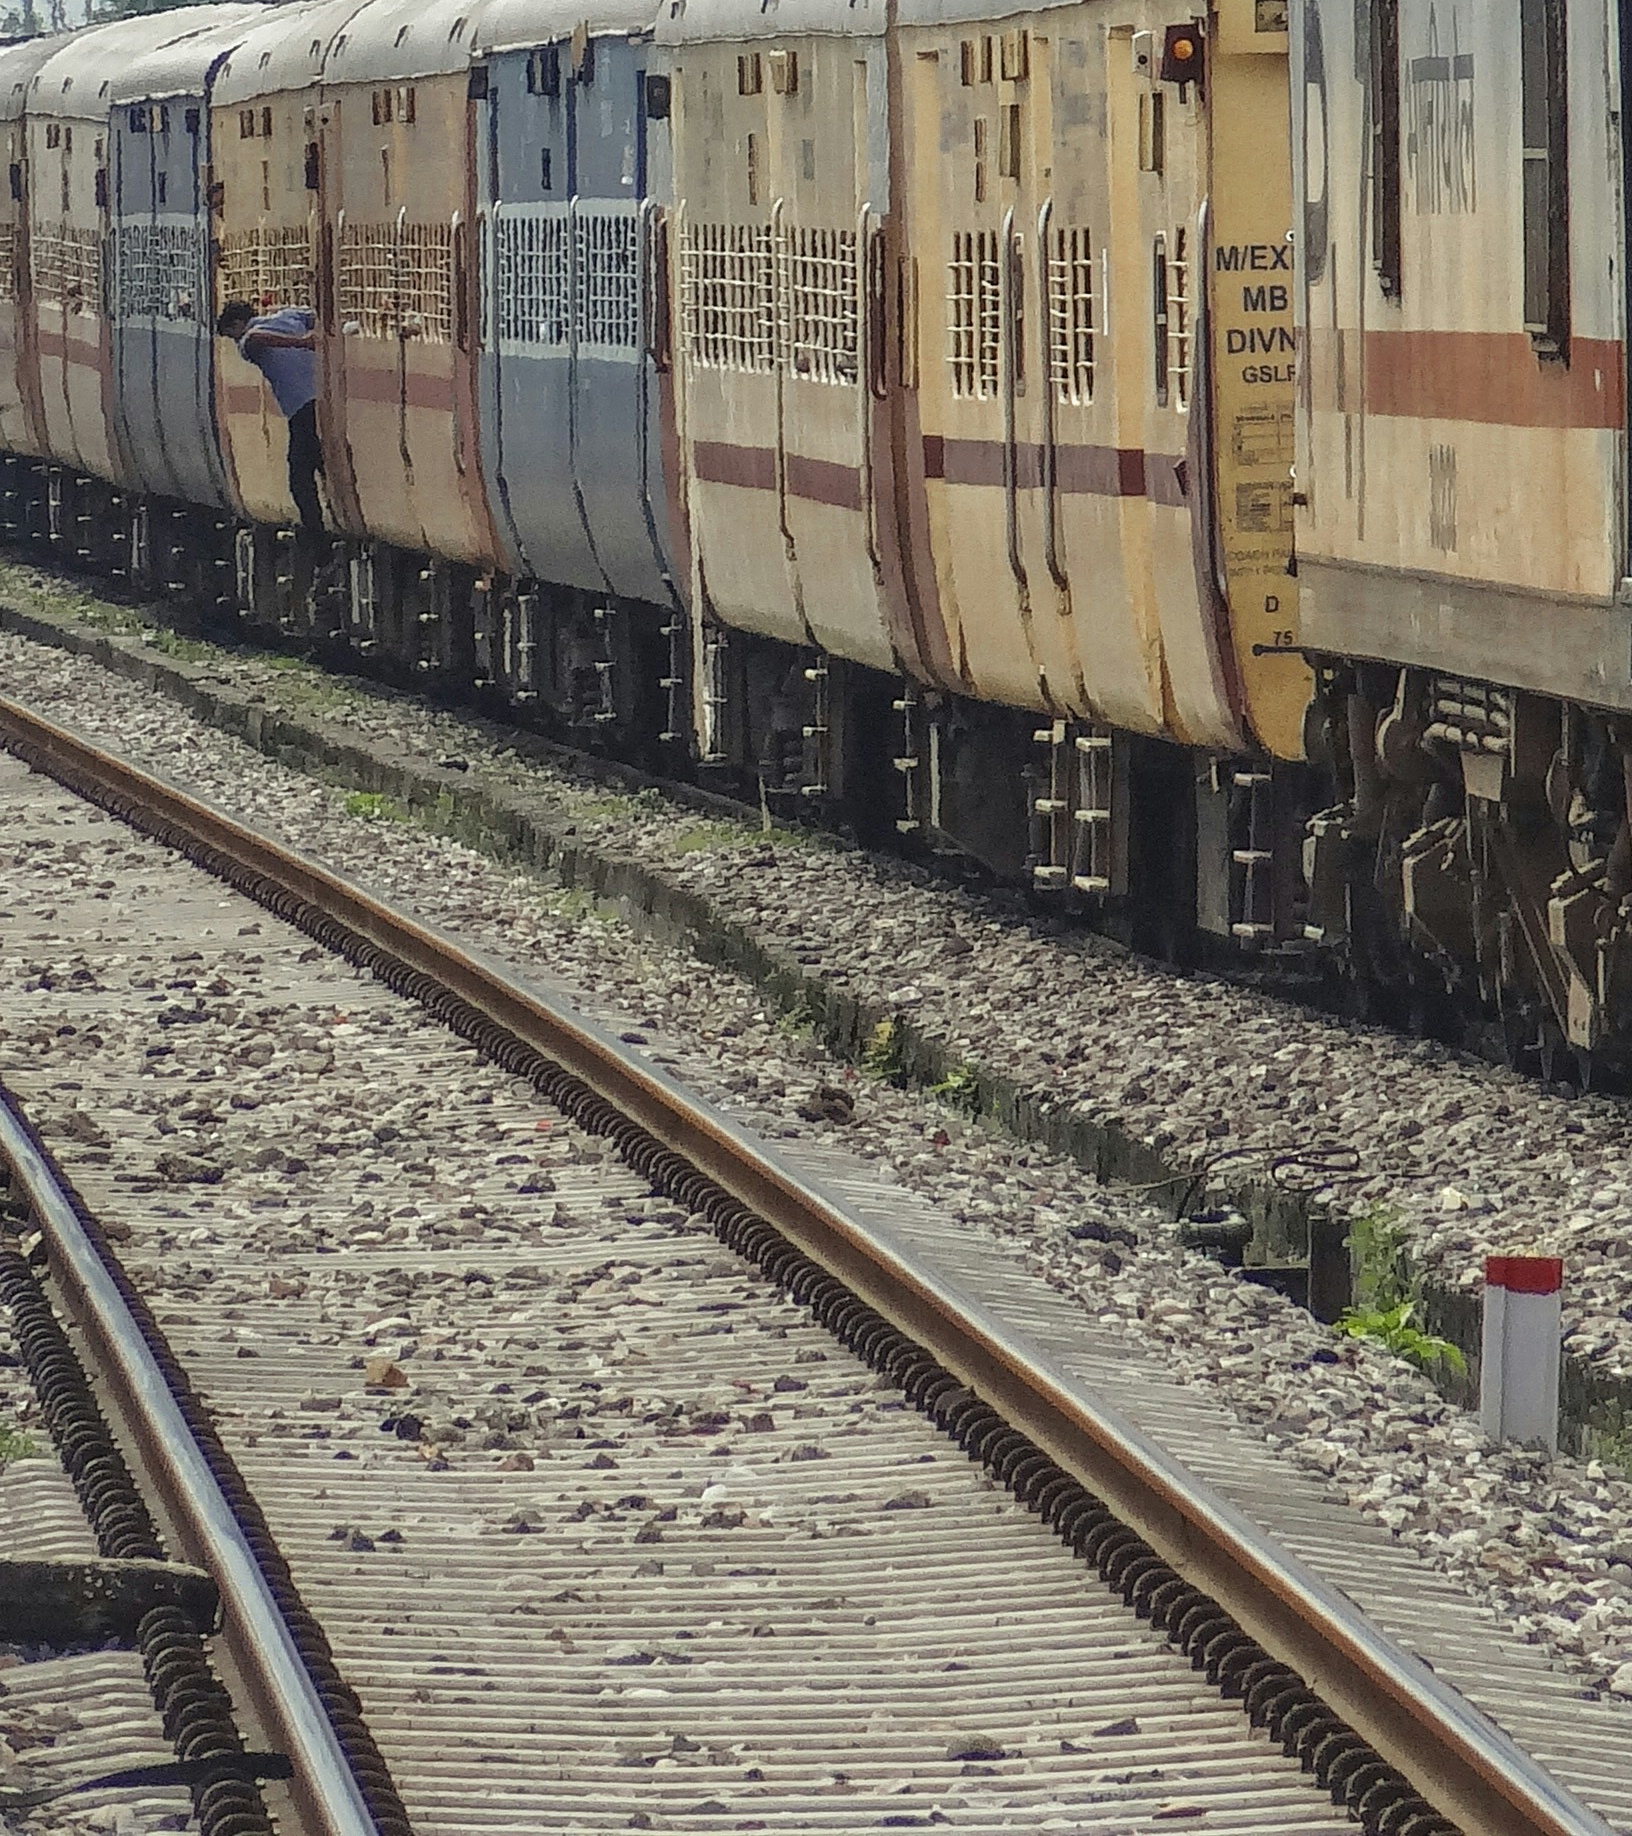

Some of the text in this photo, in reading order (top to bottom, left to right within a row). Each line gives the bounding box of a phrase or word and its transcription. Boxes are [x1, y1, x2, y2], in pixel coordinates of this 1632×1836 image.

[1216, 245, 1295, 271] M/EX
[1243, 285, 1288, 312] MB
[1265, 595, 1279, 613] D
